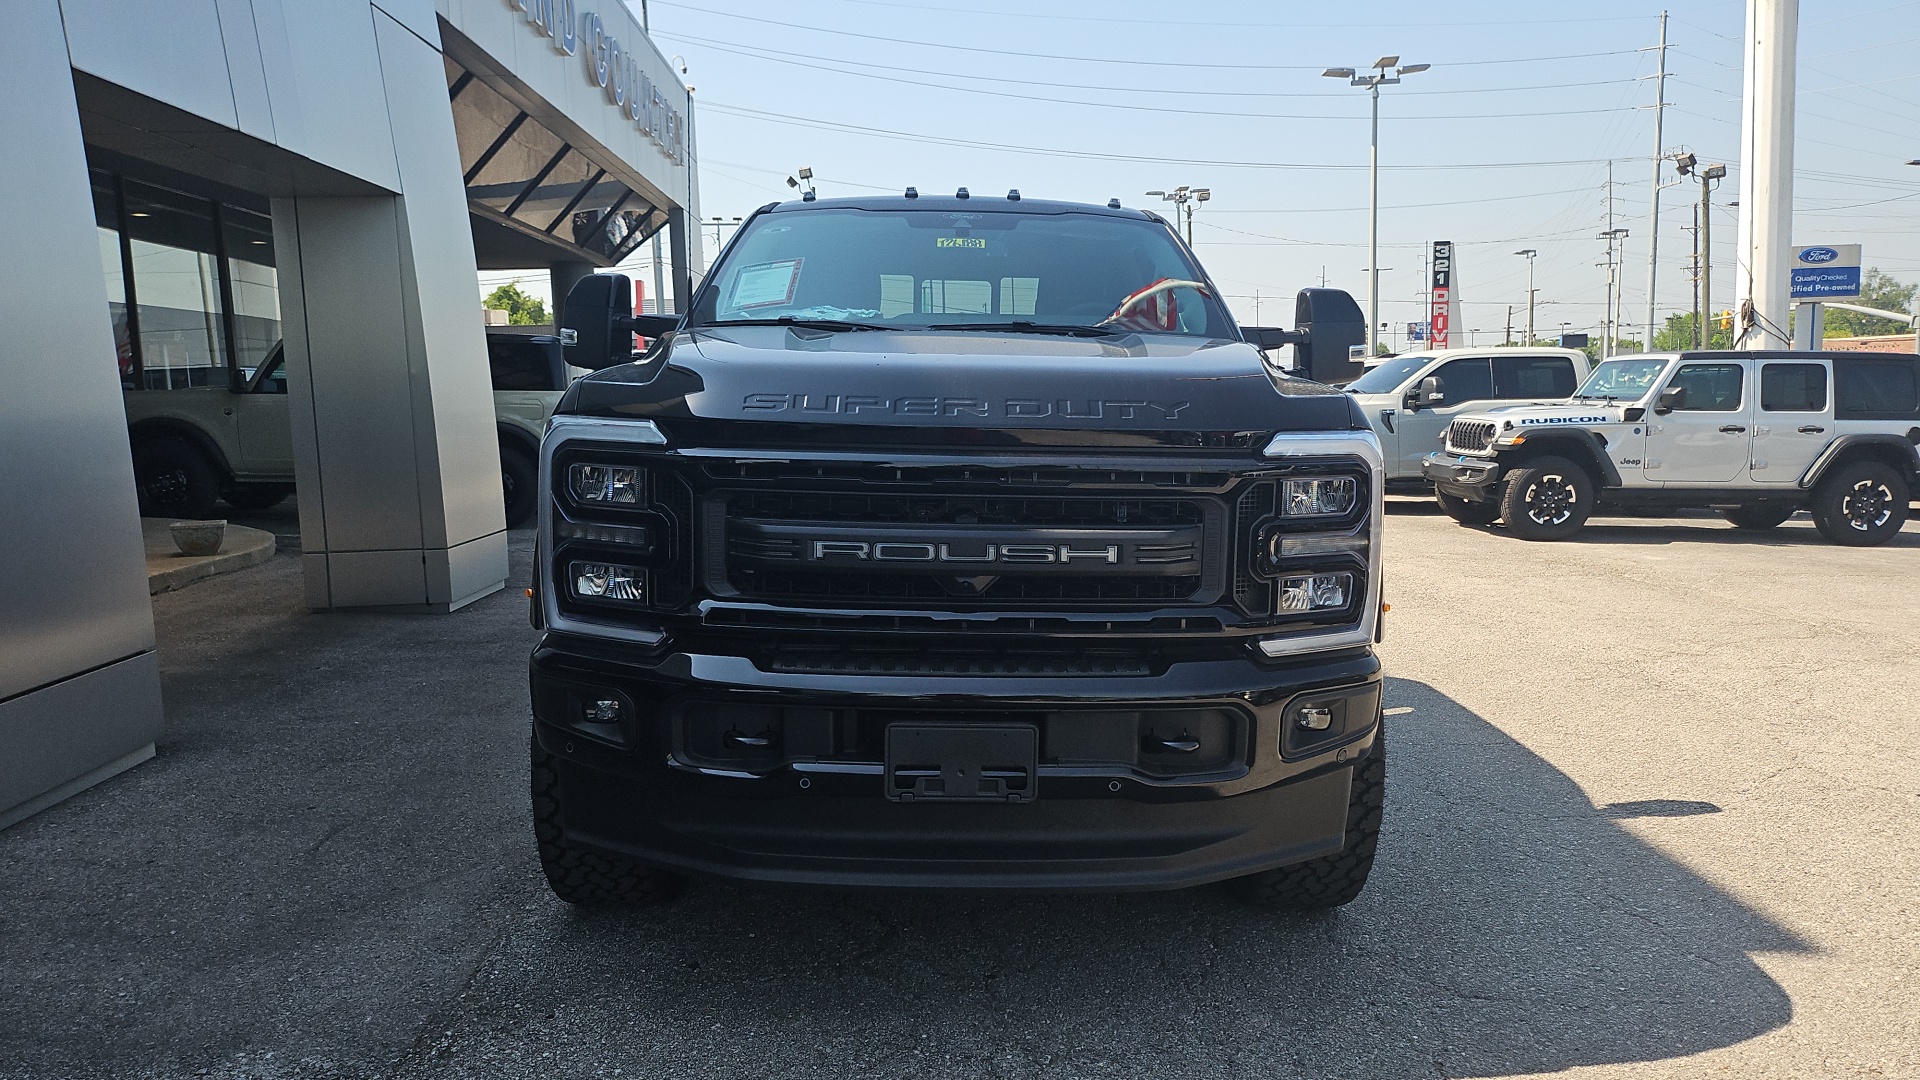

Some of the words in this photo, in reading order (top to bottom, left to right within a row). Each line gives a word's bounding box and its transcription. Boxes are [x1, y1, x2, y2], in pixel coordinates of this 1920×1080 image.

[585, 12, 685, 167] COUNTRY
[1807, 250, 1832, 261] Ford
[1435, 245, 1450, 285] 321
[1815, 283, 1856, 292] Pre-owned
[742, 394, 988, 417] SUPER
[1005, 398, 1190, 419] DUTY
[1521, 416, 1607, 425] RUBICON
[1620, 457, 1641, 466] Jeep
[813, 541, 1118, 564] ROUSH
